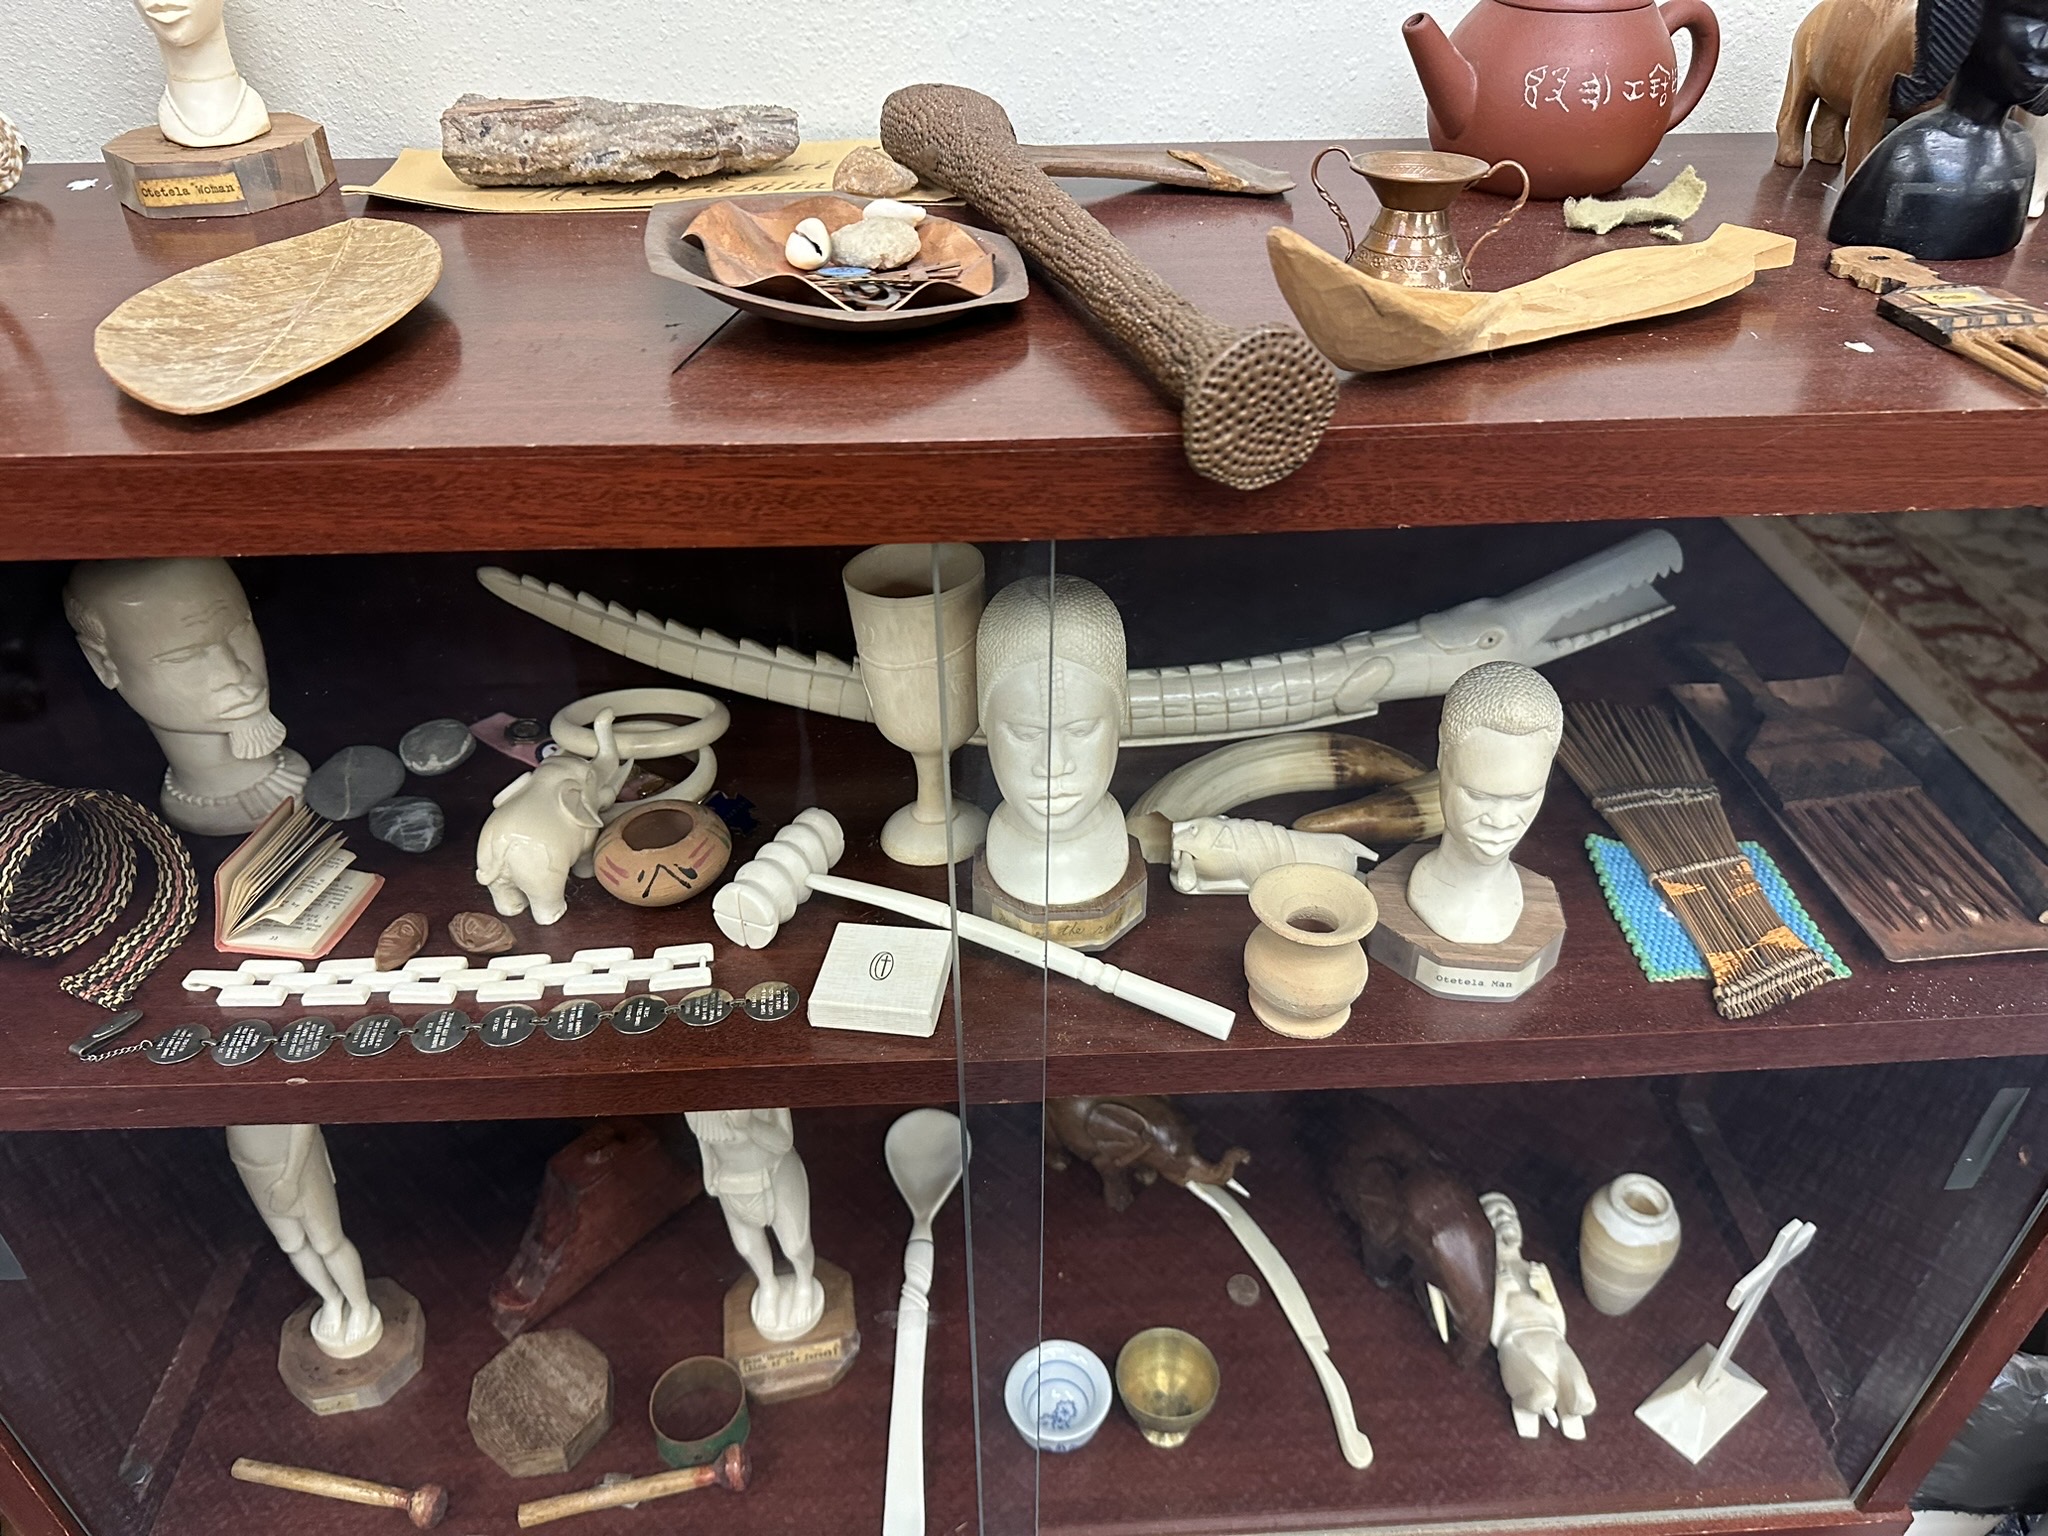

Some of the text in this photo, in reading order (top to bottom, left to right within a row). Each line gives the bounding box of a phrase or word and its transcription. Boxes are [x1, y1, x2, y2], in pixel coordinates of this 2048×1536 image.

[141, 183, 236, 198] Otetela Woman
[1057, 922, 1086, 936] the
[1435, 974, 1513, 988] Otetela Man
